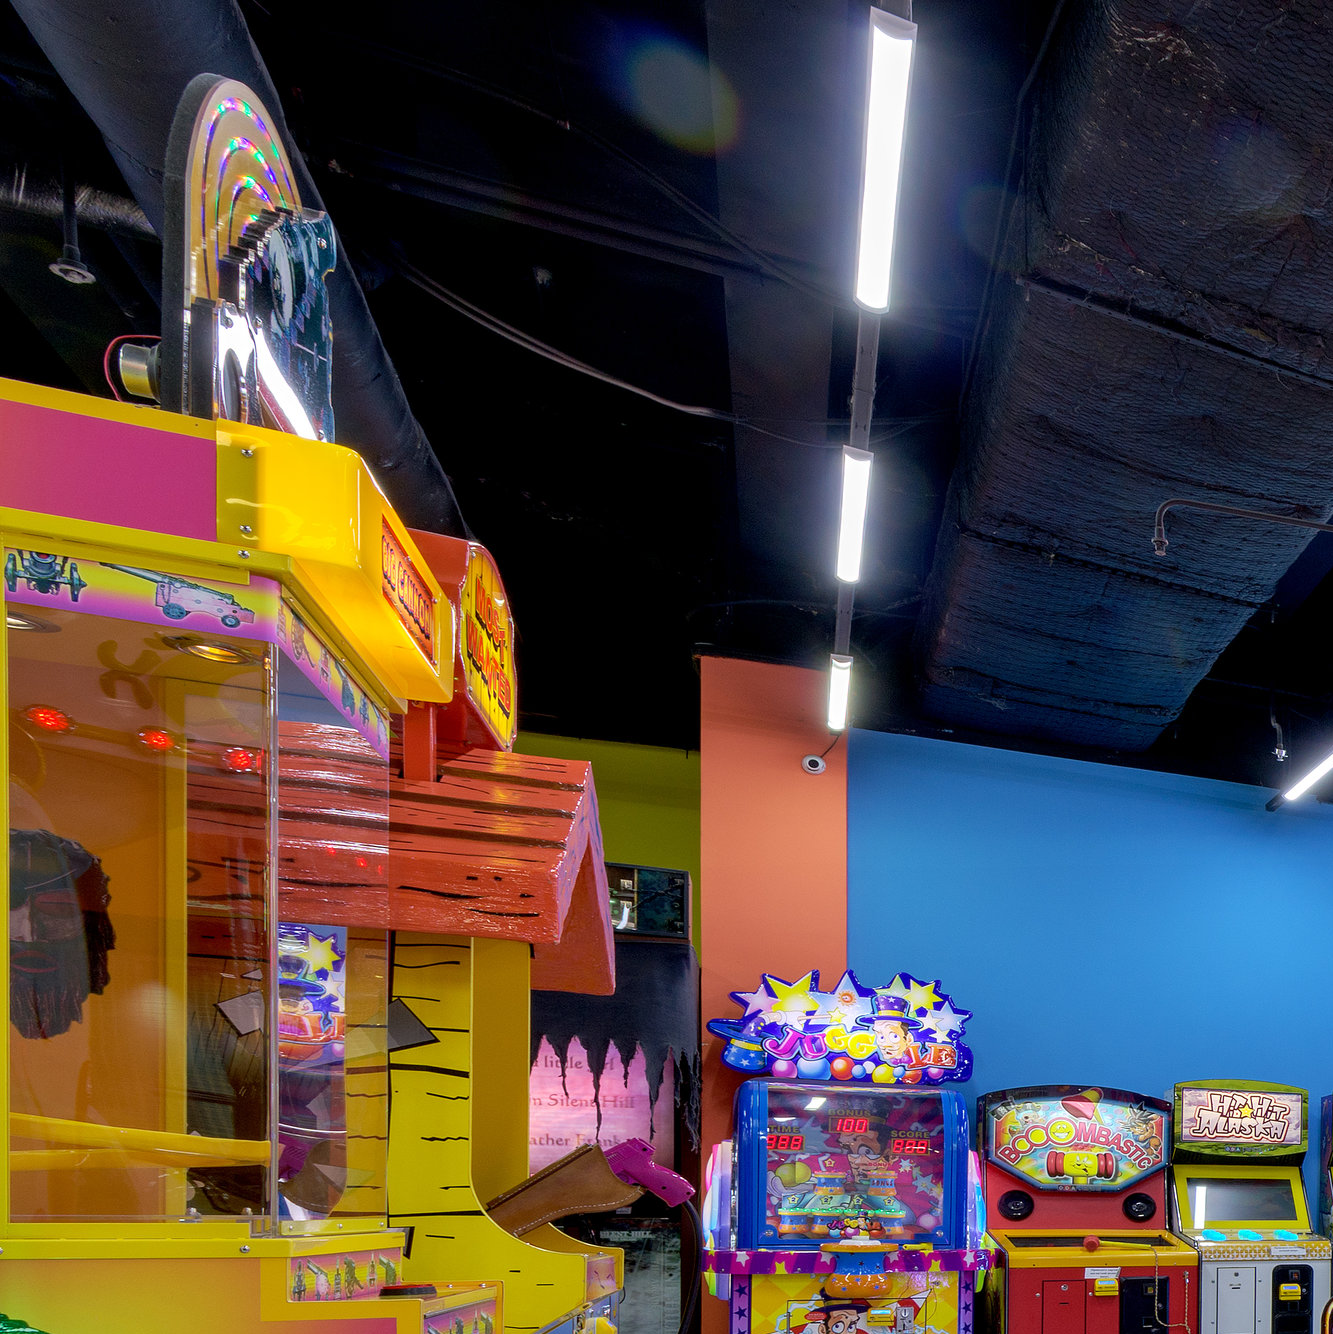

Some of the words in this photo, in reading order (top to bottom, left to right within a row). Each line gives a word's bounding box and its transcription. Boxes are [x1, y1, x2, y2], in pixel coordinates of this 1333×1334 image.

[382, 535, 396, 592] BIG
[398, 561, 431, 640] CANNON
[475, 575, 505, 669] MOST
[466, 613, 511, 719] WANTED
[762, 1025, 957, 1069] JUGGLE
[544, 1056, 583, 1069] litle
[602, 1095, 636, 1109] Hill
[828, 1108, 871, 1118] BONUS
[769, 1125, 800, 1134] TIME
[836, 1118, 868, 1133] 100
[1191, 1107, 1286, 1140] ALASKA
[891, 1130, 931, 1138] SCORE
